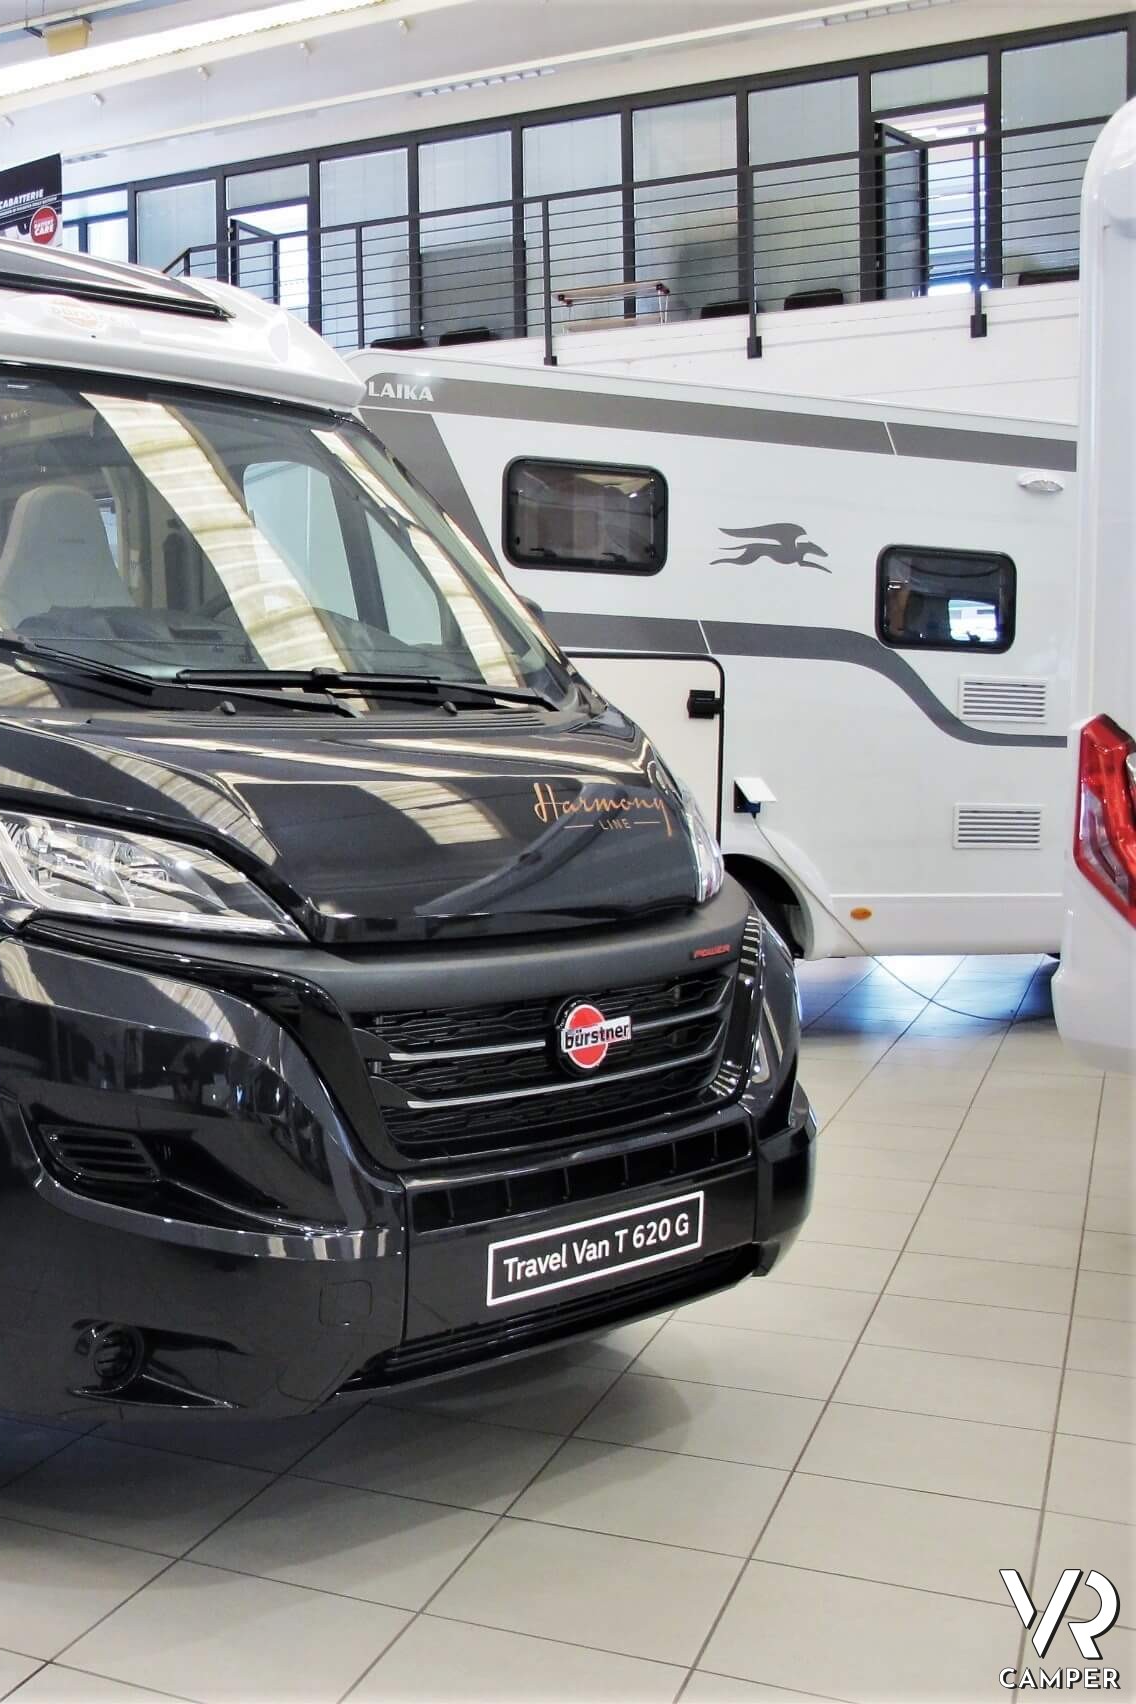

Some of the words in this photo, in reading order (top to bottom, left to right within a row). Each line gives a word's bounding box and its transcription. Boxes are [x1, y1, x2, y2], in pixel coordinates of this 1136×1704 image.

[368, 381, 435, 402] LAIKA
[533, 782, 674, 838] Harmony
[599, 818, 632, 831] LINE
[564, 1024, 629, 1050] bürstner
[503, 1243, 568, 1283] Travel
[572, 1239, 610, 1265] Van
[614, 1228, 629, 1254] T
[632, 1217, 671, 1249] 620
[675, 1212, 689, 1237] G
